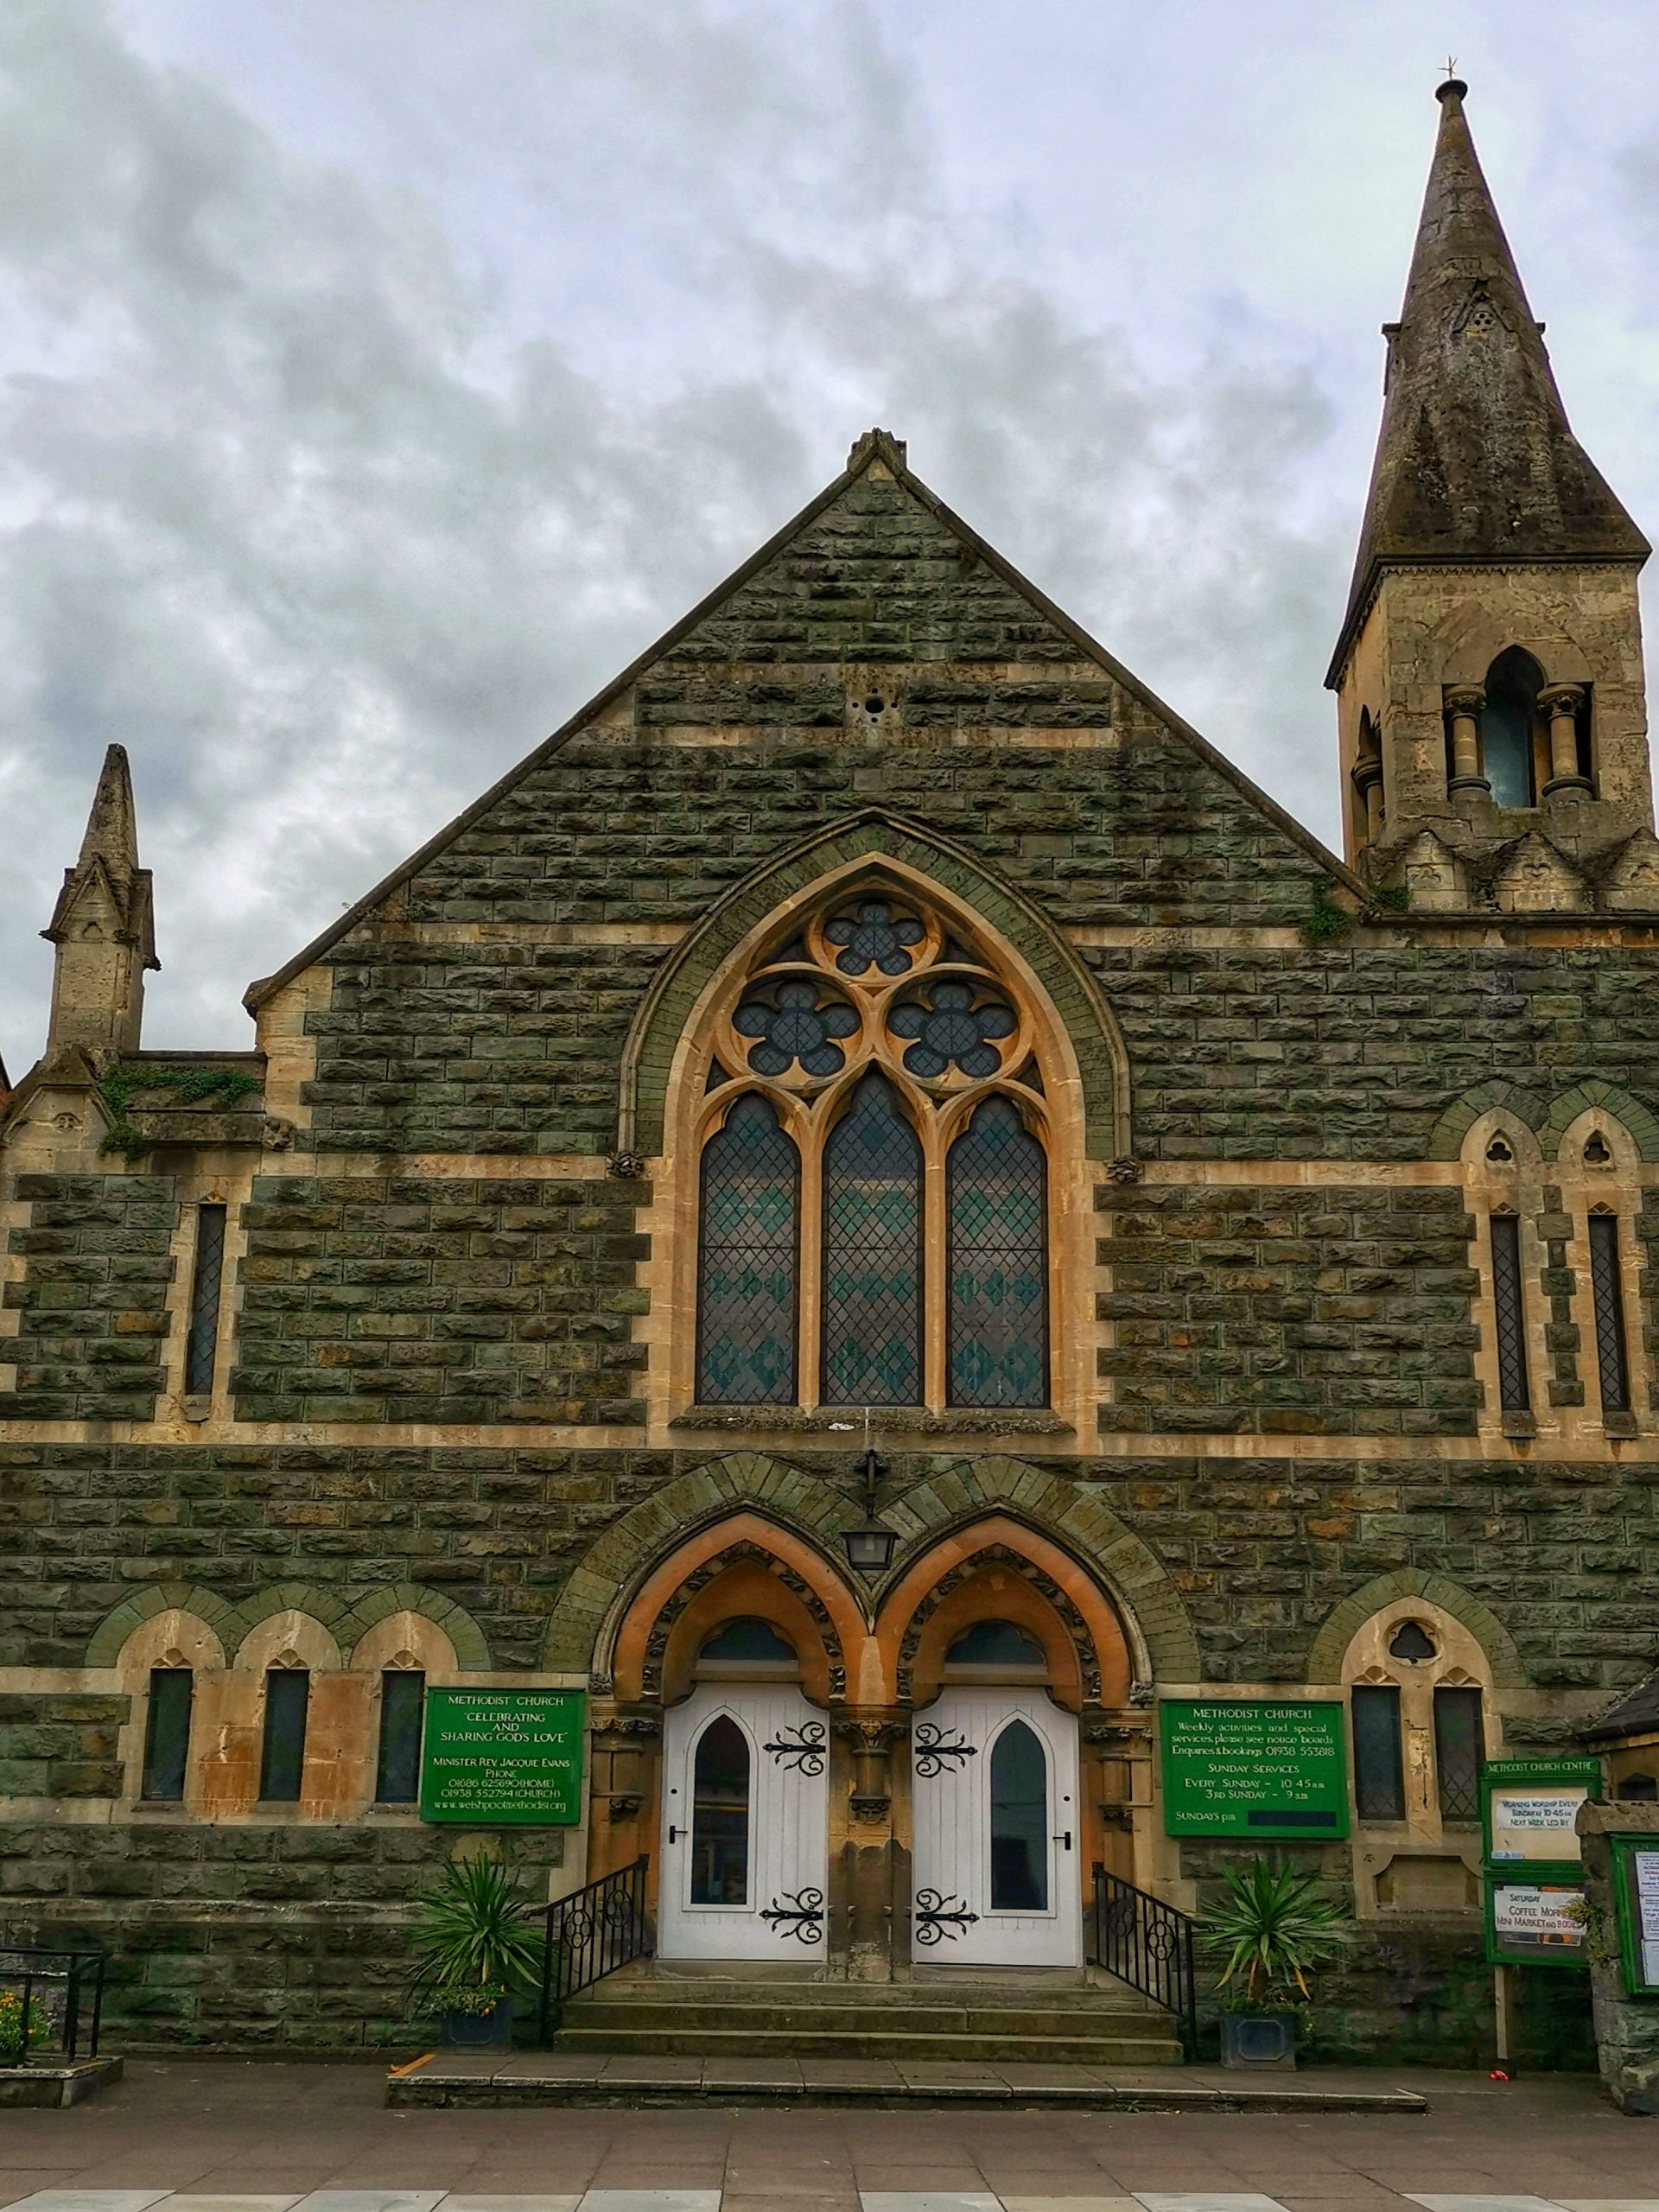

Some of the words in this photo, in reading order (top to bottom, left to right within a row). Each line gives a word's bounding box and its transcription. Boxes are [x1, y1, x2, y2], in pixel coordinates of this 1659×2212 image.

[448, 1696, 511, 1705] METHODIST
[517, 1696, 563, 1706] CHURCH
[1193, 1709, 1259, 1719] METHODIST
[1264, 1709, 1312, 1719] CHURCH
[1178, 1722, 1214, 1733] Weekly
[1218, 1724, 1262, 1732] activities
[1268, 1724, 1287, 1732] and
[1294, 1724, 1326, 1734] special
[441, 1732, 493, 1742] SHARING
[1301, 1735, 1333, 1744] boards
[1266, 1746, 1295, 1756] 01938
[1300, 1747, 1335, 1757] 553818
[434, 1758, 477, 1766] MINISTER
[499, 1758, 538, 1768] JACQUIE
[542, 1758, 570, 1767] EVANS
[1489, 1763, 1529, 1773] METHODIST
[1530, 1762, 1560, 1771] CHURCH
[1562, 1761, 1592, 1770] CENTRE
[486, 1769, 517, 1778] PHONE
[1208, 1764, 1249, 1773] SUNDAY
[1253, 1764, 1300, 1774] SERVICES
[1185, 1778, 1216, 1788] EVERY
[1222, 1778, 1261, 1788] SUNDAY
[441, 1789, 472, 1798] 01938
[1229, 1790, 1266, 1799] SUNDAY
[1176, 1812, 1220, 1821] SUNDAYS
[1510, 1894, 1541, 1903] SATURDAY
[1509, 1905, 1537, 1916] COFFEE
[1514, 1917, 1546, 1928] MARKET
